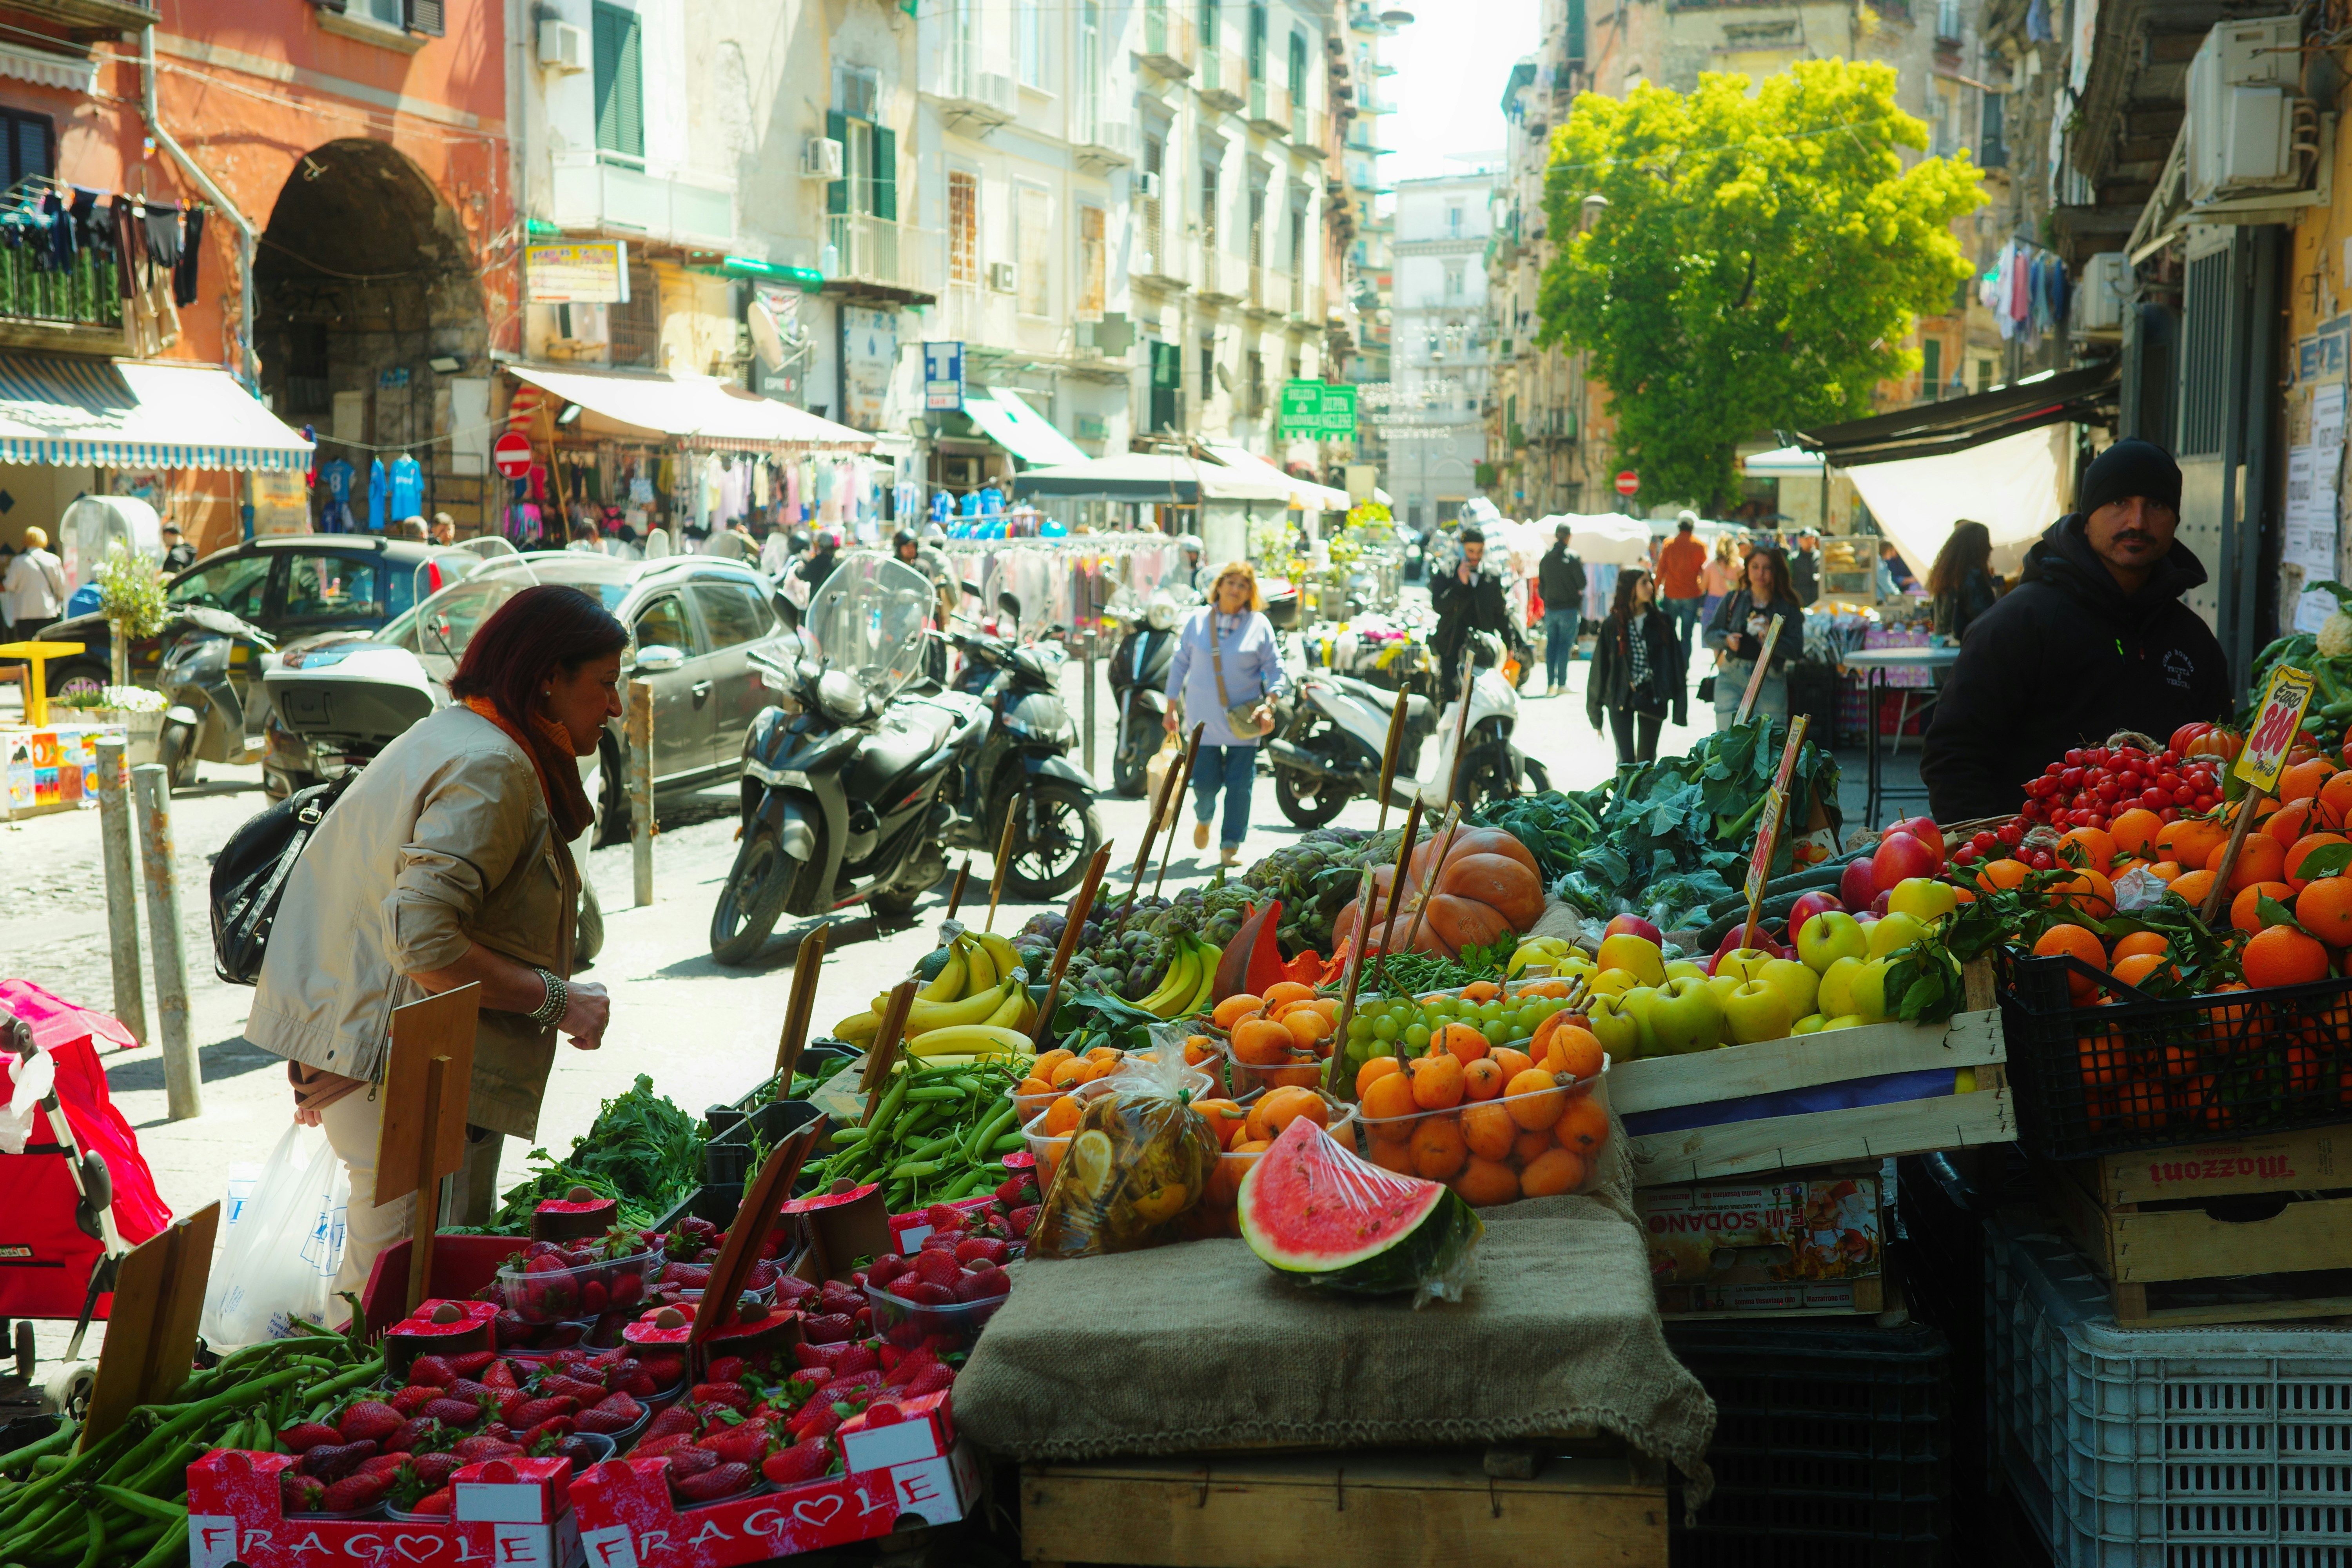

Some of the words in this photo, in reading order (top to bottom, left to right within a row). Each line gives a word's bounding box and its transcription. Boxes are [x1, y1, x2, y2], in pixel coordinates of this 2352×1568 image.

[927, 343, 958, 379] T
[2167, 665, 2190, 676] FRUTTA
[2195, 1146, 2242, 1156] FERRARA
[2149, 1154, 2295, 1188] Mazzoni
[1647, 1210, 1758, 1234] SODANO
